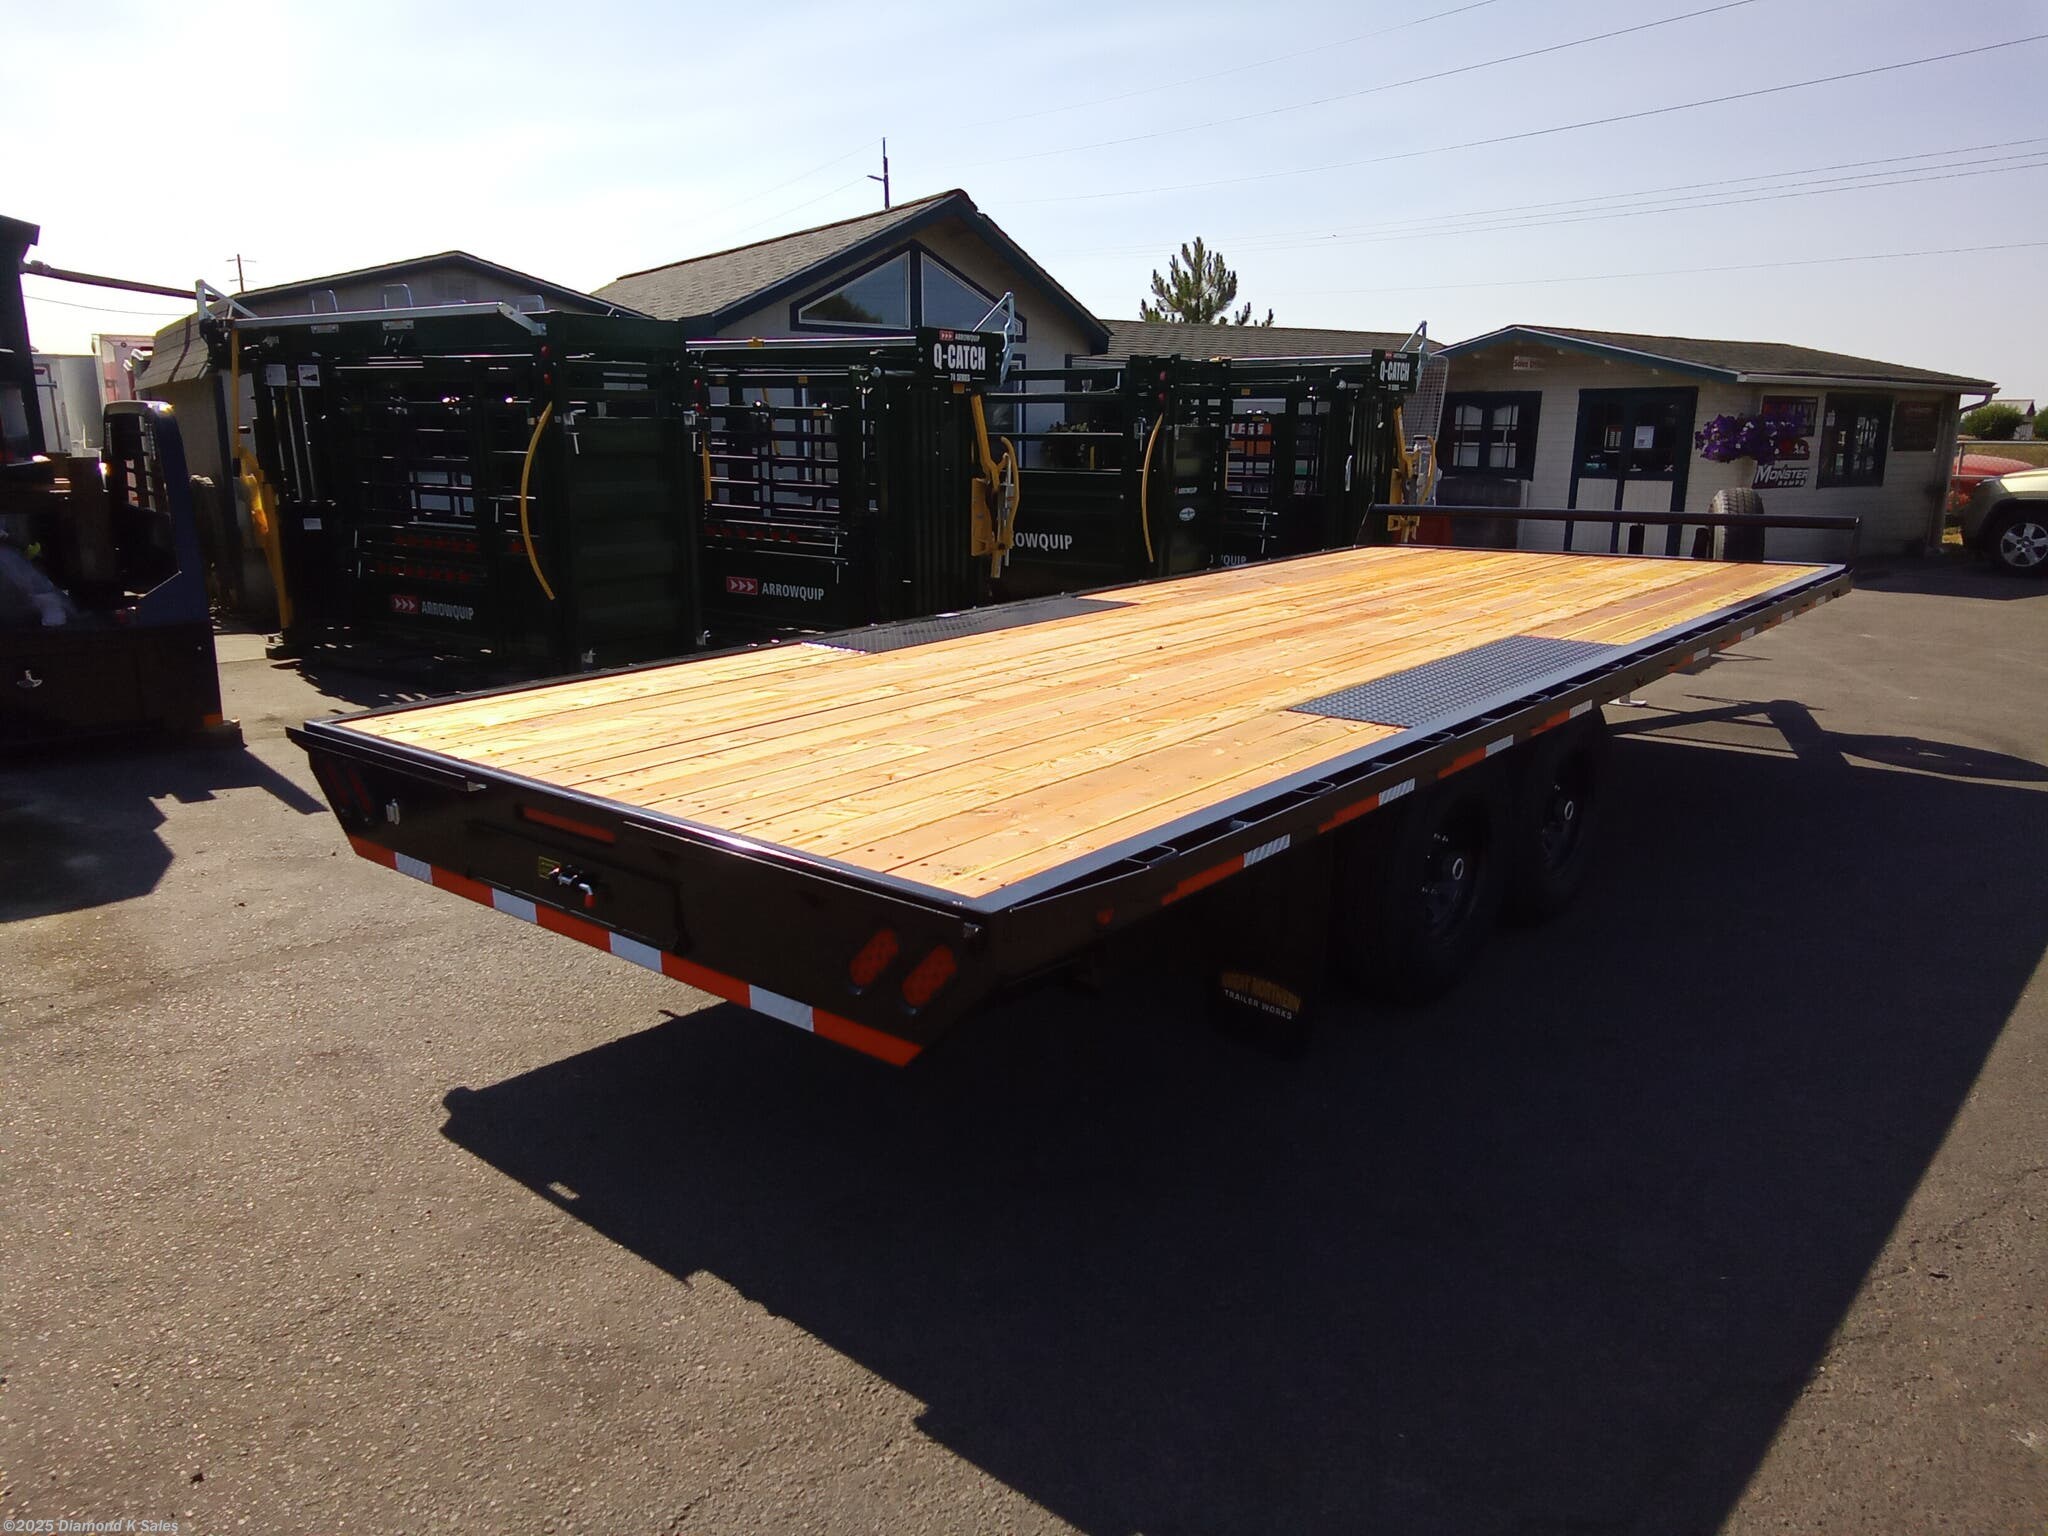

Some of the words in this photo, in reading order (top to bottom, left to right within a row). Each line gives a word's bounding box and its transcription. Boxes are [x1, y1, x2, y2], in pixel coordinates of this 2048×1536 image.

[933, 343, 986, 370] Q-CATCH
[1380, 361, 1410, 382] Q-CATCH
[1754, 464, 1808, 484] MONSTER
[1015, 532, 1073, 552] OWQUIP
[762, 582, 825, 602] ARROWQUIP
[1224, 989, 1259, 1007] TRAILER
[1261, 1002, 1293, 1020] WORKS
